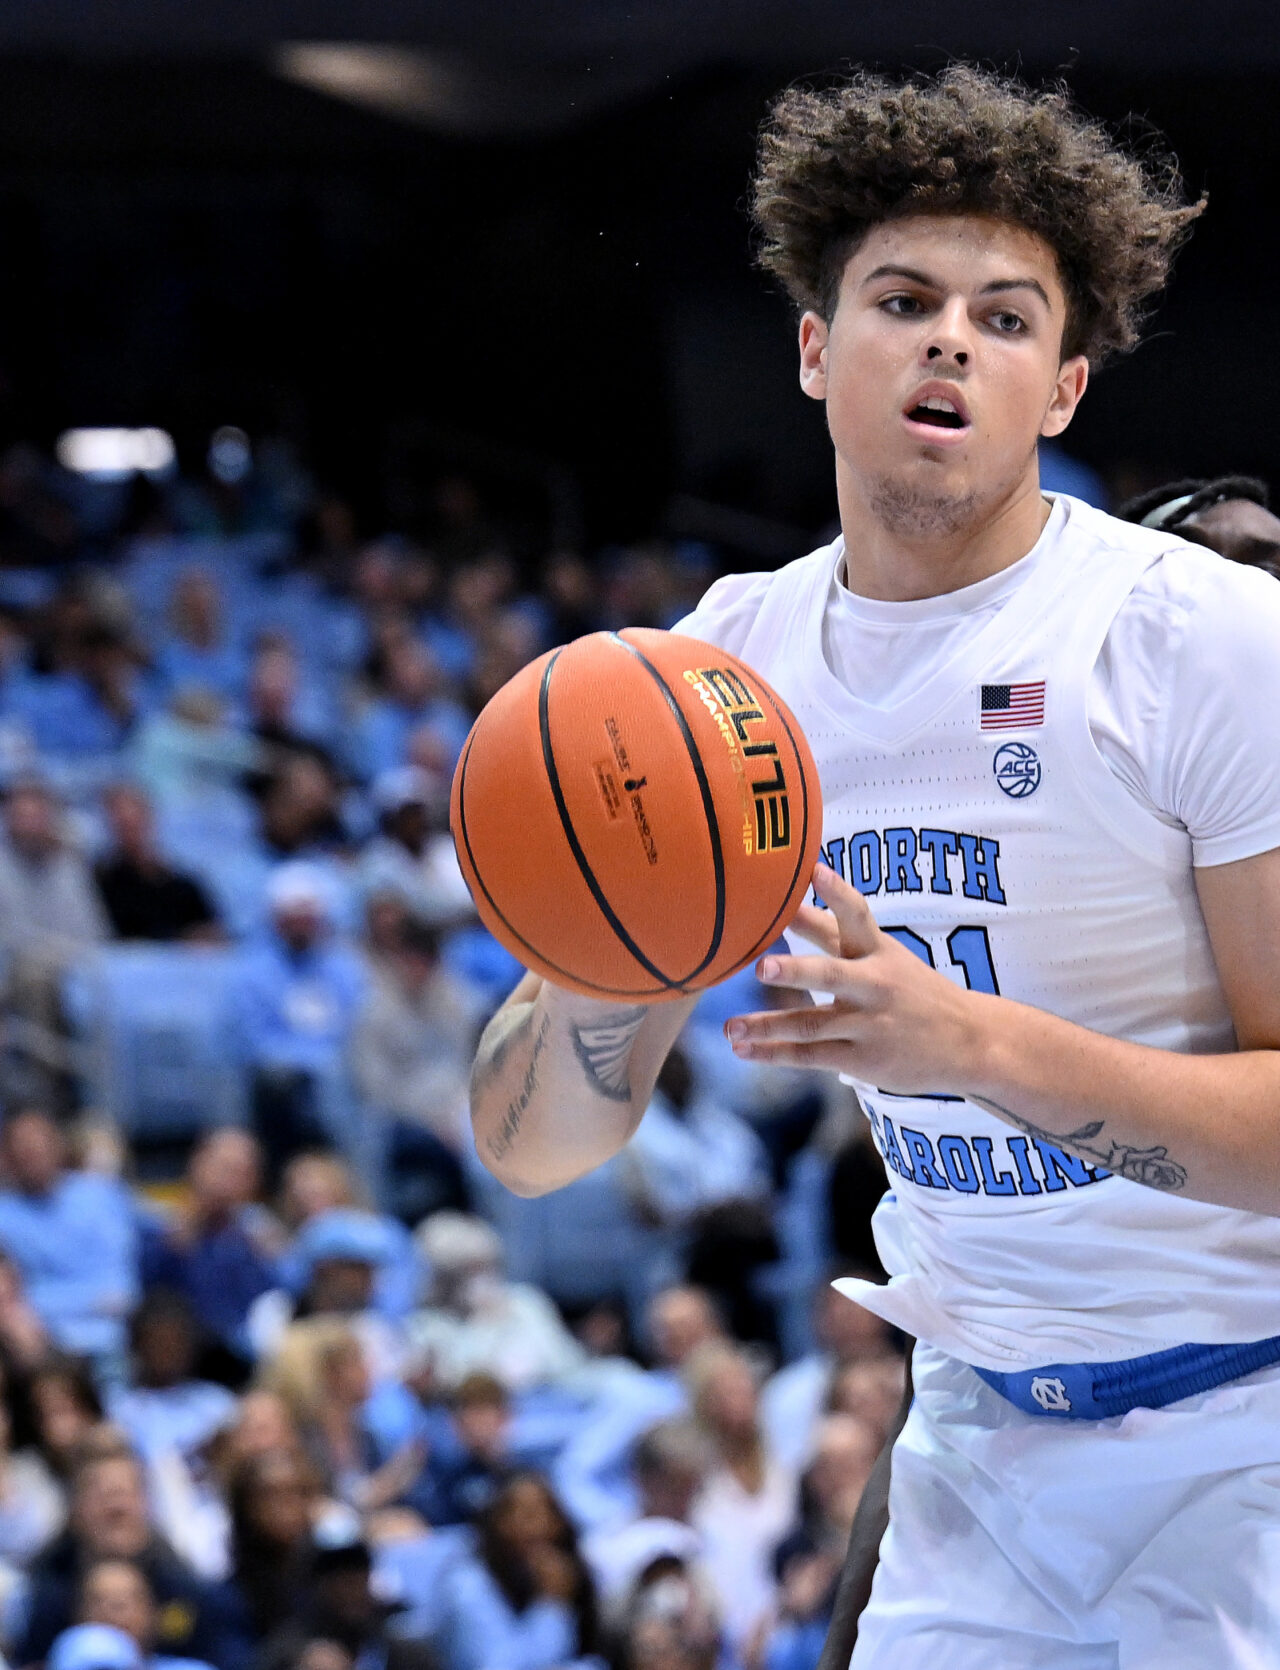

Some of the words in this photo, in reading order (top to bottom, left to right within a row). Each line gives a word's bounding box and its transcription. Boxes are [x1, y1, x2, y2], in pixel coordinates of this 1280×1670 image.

[696, 667, 791, 854] ELITE
[1000, 759, 1037, 776] ACC
[864, 1099, 1113, 1196] CAROLIN
